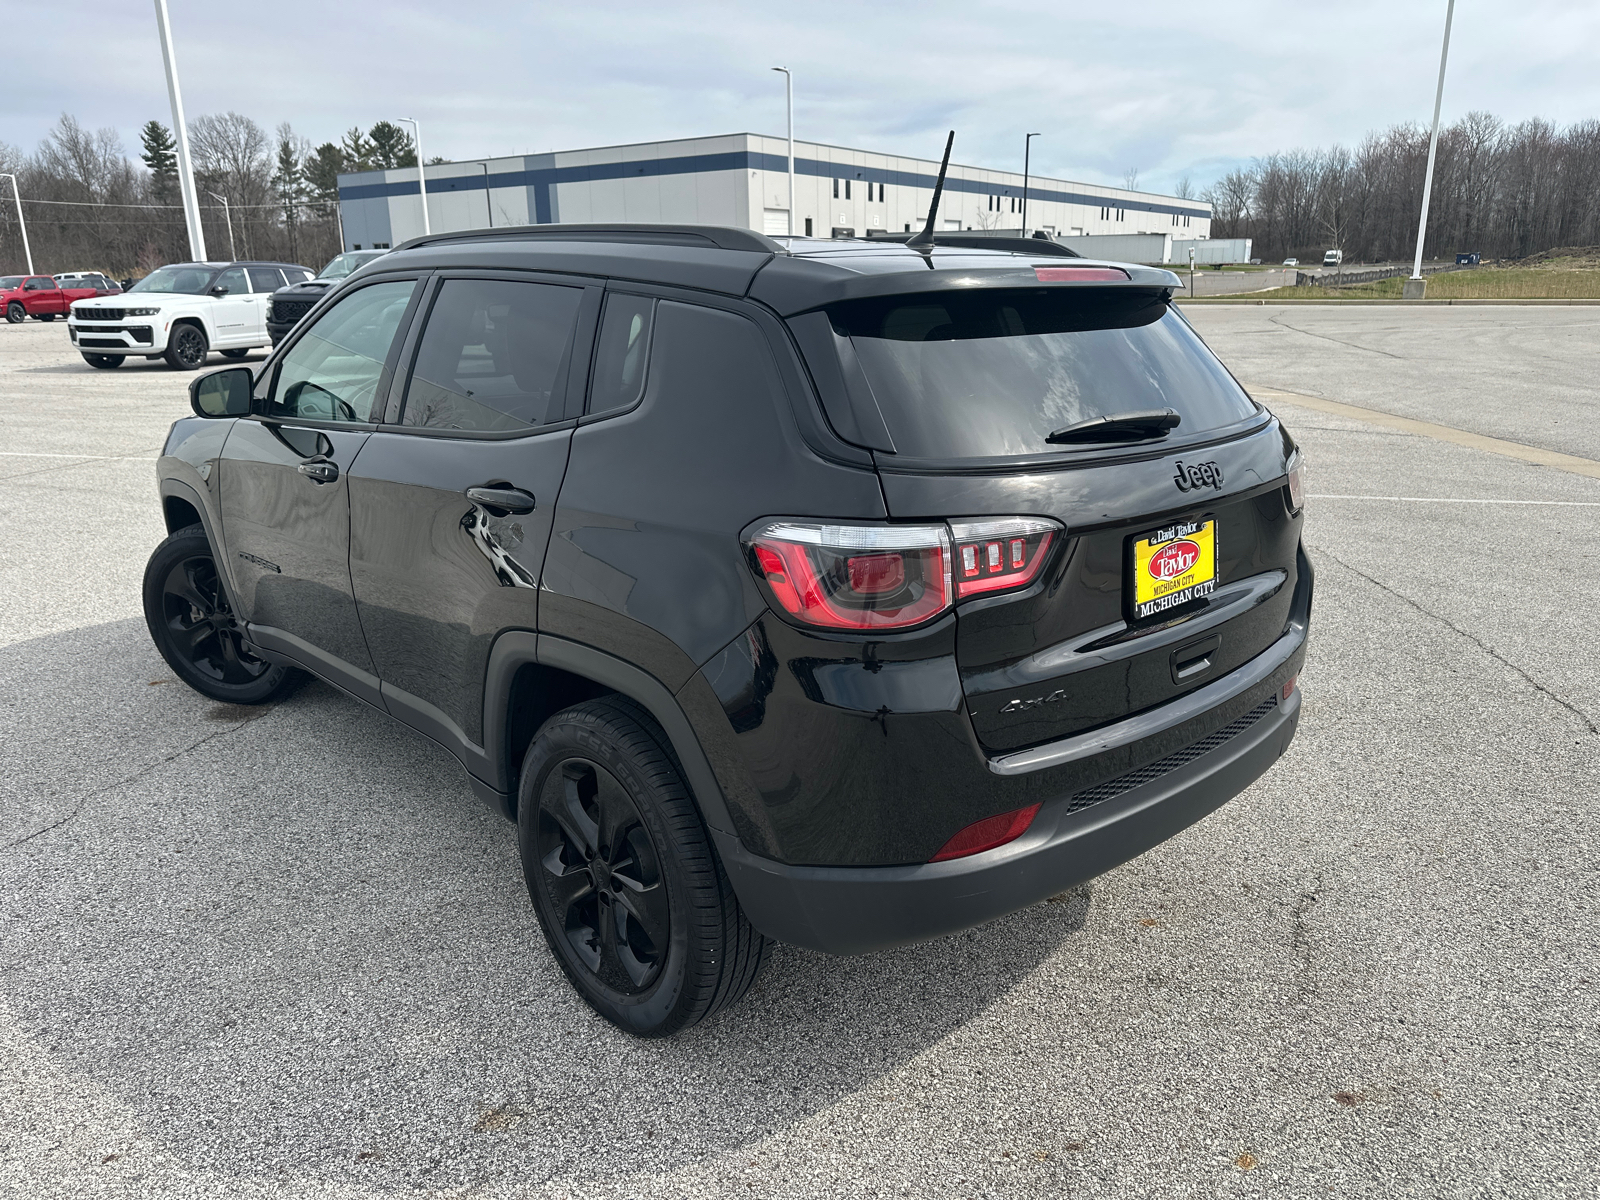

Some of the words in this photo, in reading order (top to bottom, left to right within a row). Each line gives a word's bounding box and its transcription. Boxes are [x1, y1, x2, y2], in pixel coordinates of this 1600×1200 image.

[1173, 460, 1224, 493] Jeep
[1157, 525, 1175, 543] David
[1176, 521, 1198, 539] Taylor
[1157, 550, 1195, 578] Taylor
[1163, 545, 1178, 558] David
[1140, 587, 1193, 618] MICHIGAN
[1194, 579, 1216, 598] CITY
[1153, 578, 1181, 597] MICHIGAN
[1181, 574, 1195, 586] CITY
[615, 762, 668, 852] GRAND
